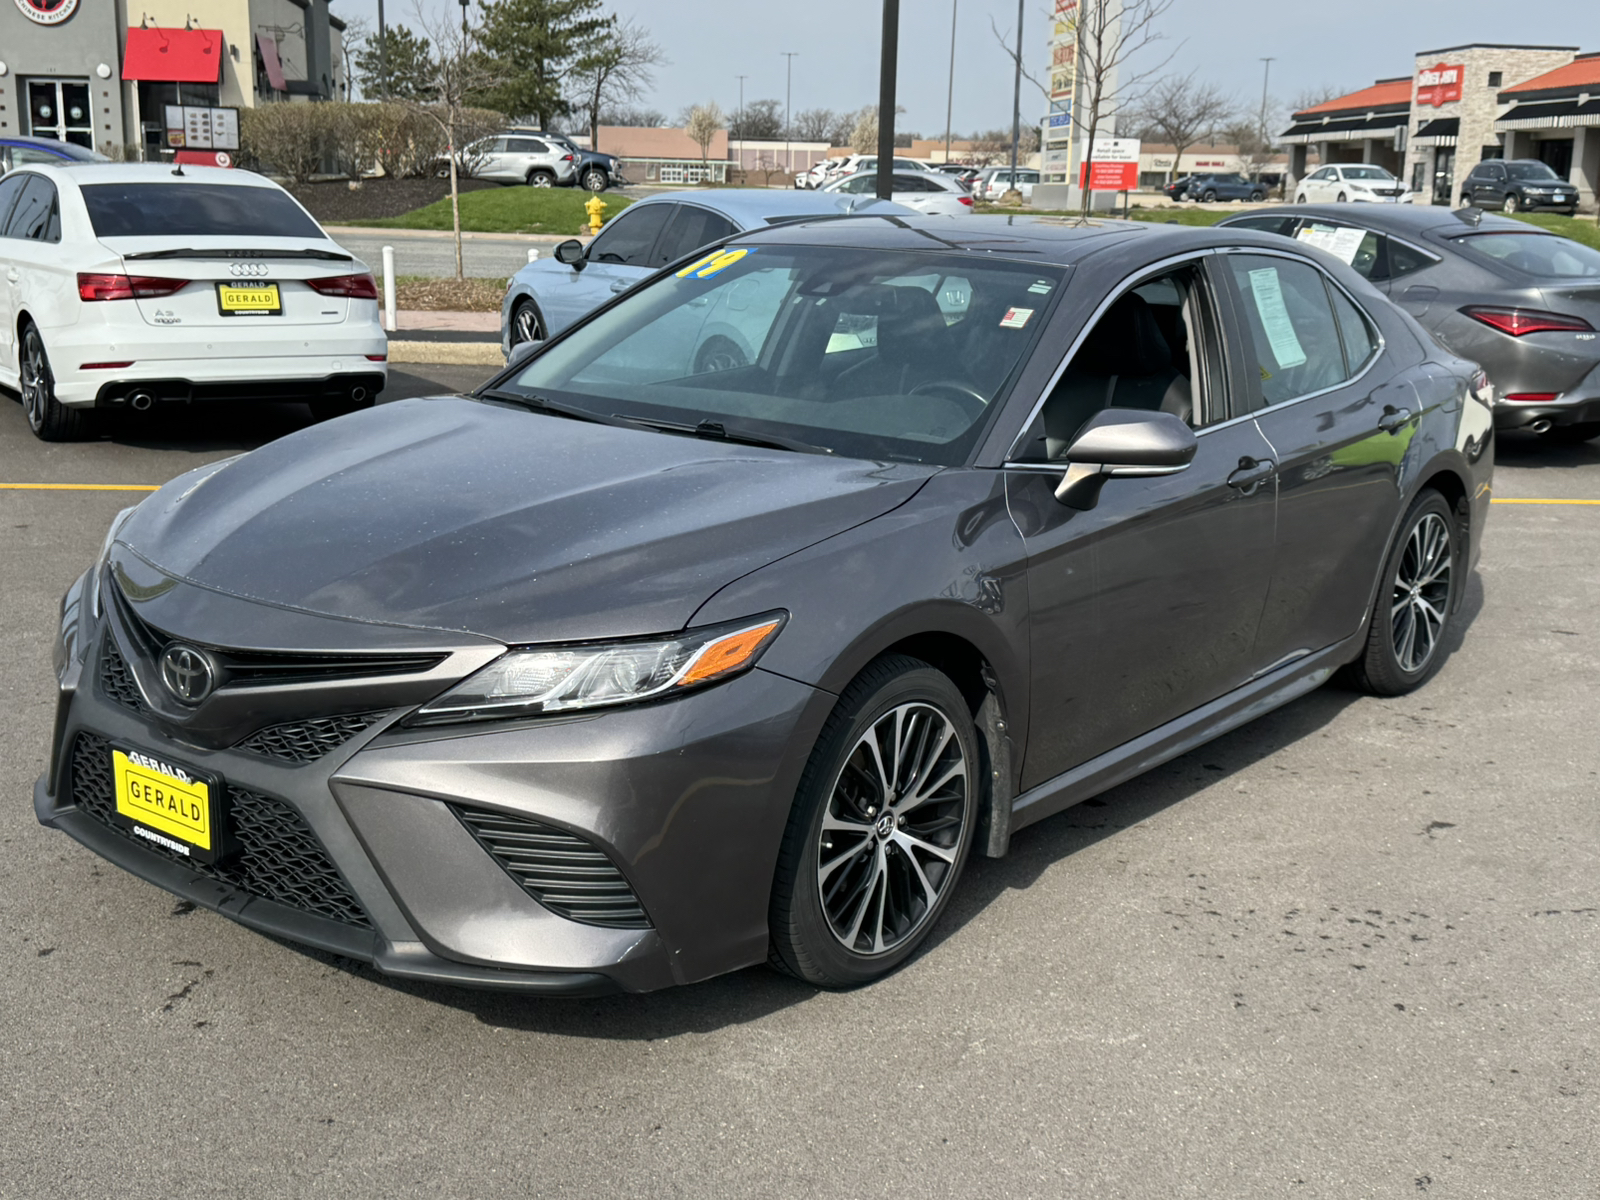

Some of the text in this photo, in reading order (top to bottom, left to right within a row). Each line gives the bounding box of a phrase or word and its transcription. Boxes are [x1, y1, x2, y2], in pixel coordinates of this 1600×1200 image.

[48, 0, 73, 20] KITCHEN
[675, 248, 748, 278] 19
[228, 294, 271, 302] GERALD
[129, 751, 188, 784] GERALD
[130, 780, 200, 821] GERALD
[133, 825, 190, 856] COUNTRYSIDE
